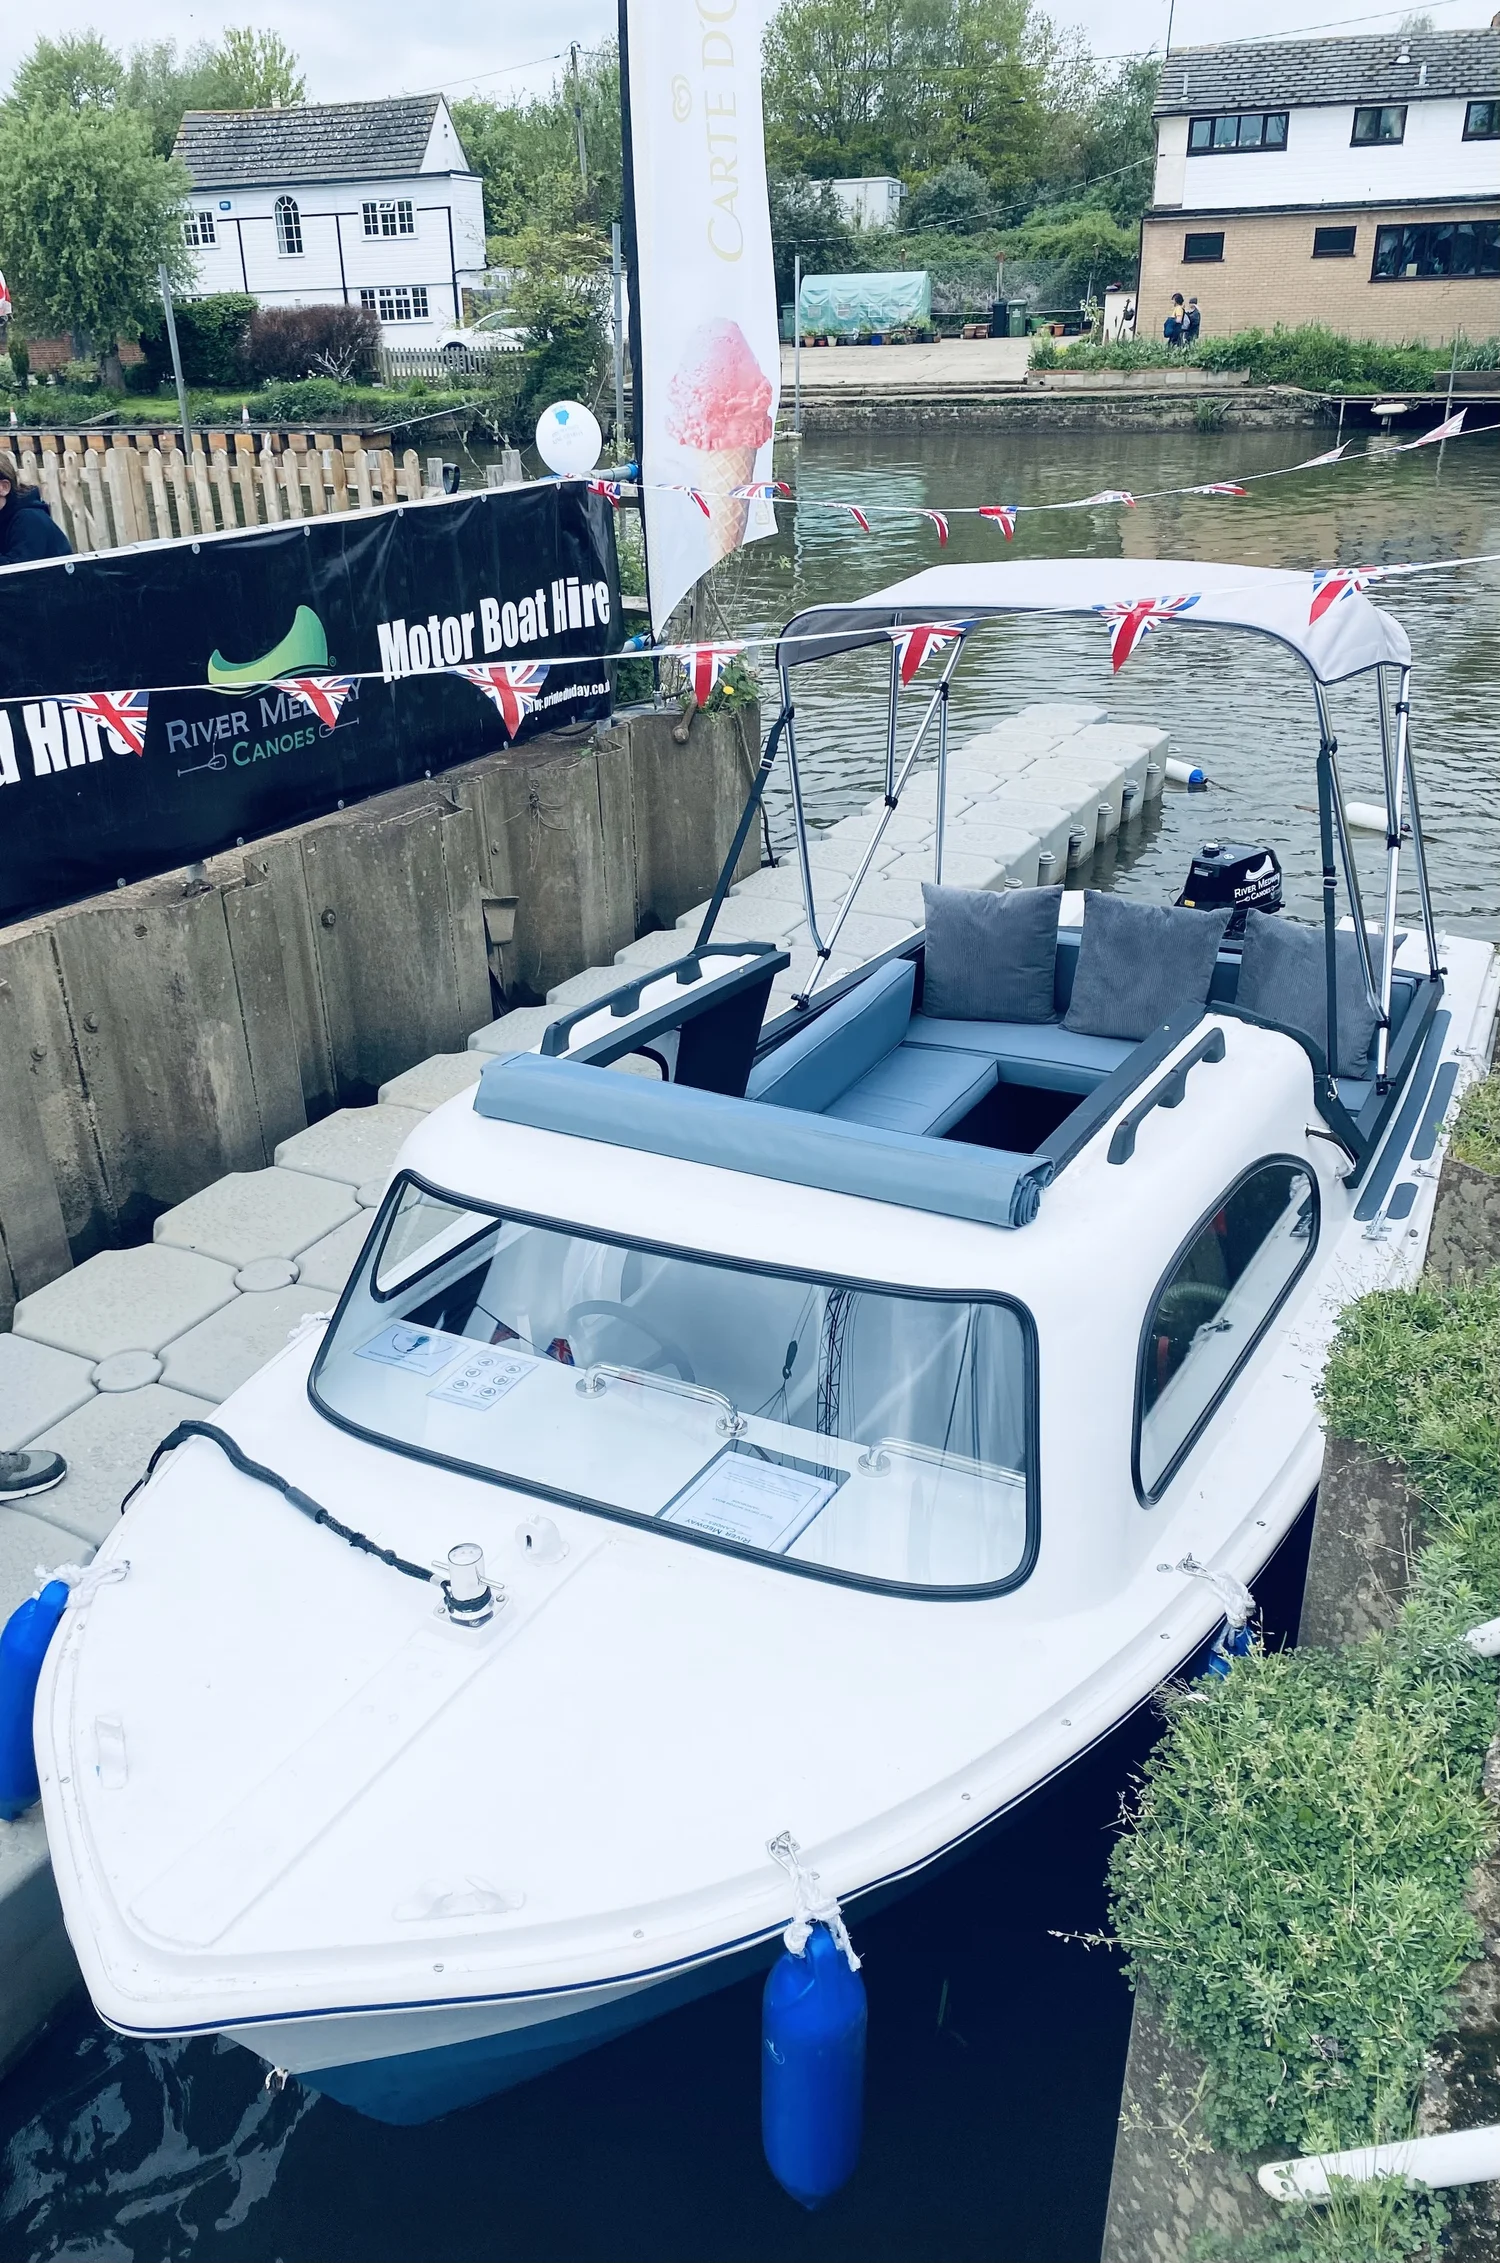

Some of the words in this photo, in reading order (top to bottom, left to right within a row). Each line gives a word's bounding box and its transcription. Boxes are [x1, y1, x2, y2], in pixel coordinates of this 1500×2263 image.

[705, 89, 744, 263] CARTE
[376, 610, 475, 684] Motor
[479, 596, 549, 655] Boat
[550, 575, 611, 635] Hire
[164, 710, 250, 753] RIVER
[258, 677, 362, 728] MEY
[232, 727, 316, 767] CANOES
[1234, 884, 1257, 898] RIVER
[684, 1518, 723, 1535] MEDWAY
[724, 1531, 752, 1544] RIVER
